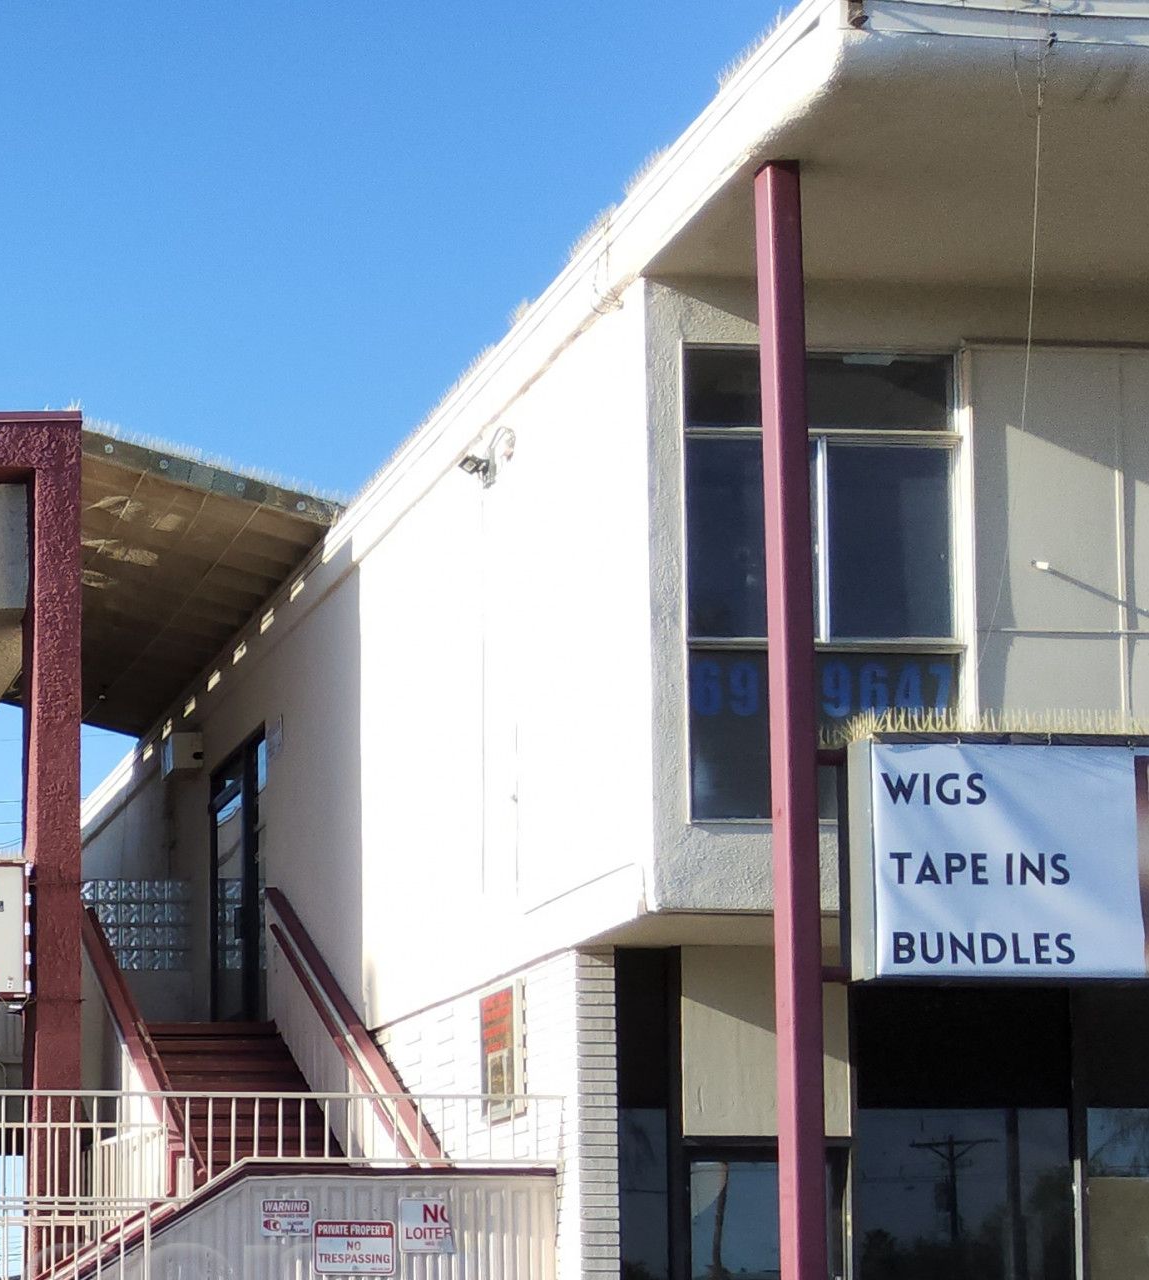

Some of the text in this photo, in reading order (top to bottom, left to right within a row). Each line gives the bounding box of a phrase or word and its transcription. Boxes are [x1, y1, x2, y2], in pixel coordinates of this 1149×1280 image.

[880, 772, 987, 806] WIGS
[889, 851, 1071, 886] TAPE INS
[892, 931, 1076, 965] BUNDLES
[264, 1201, 308, 1212] WARNING
[317, 1224, 349, 1235] PRIVATE
[350, 1225, 389, 1236] PROPERTY
[346, 1241, 361, 1251] NO
[318, 1253, 390, 1264] TRESPASSING
